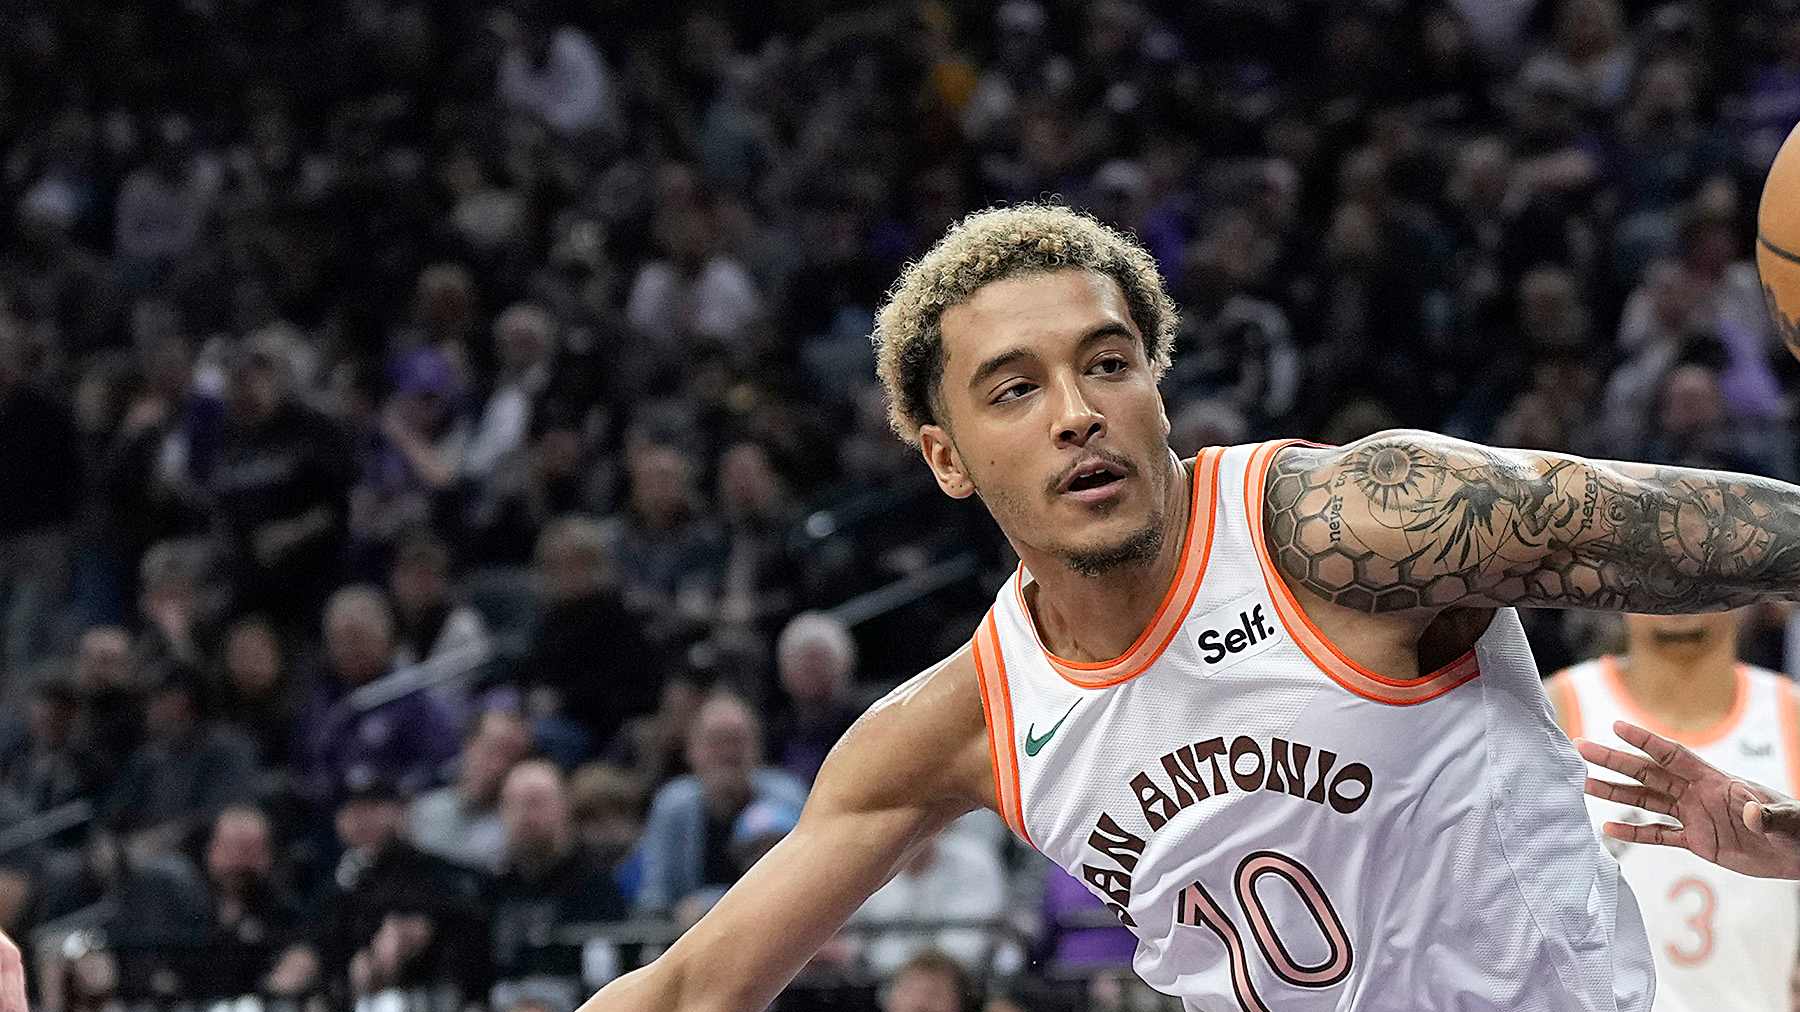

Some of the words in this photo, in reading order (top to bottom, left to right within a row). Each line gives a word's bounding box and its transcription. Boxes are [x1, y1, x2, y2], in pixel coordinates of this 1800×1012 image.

[1198, 603, 1275, 665] Self.
[1129, 735, 1373, 832] ANTONIO
[1666, 876, 1719, 968] 3
